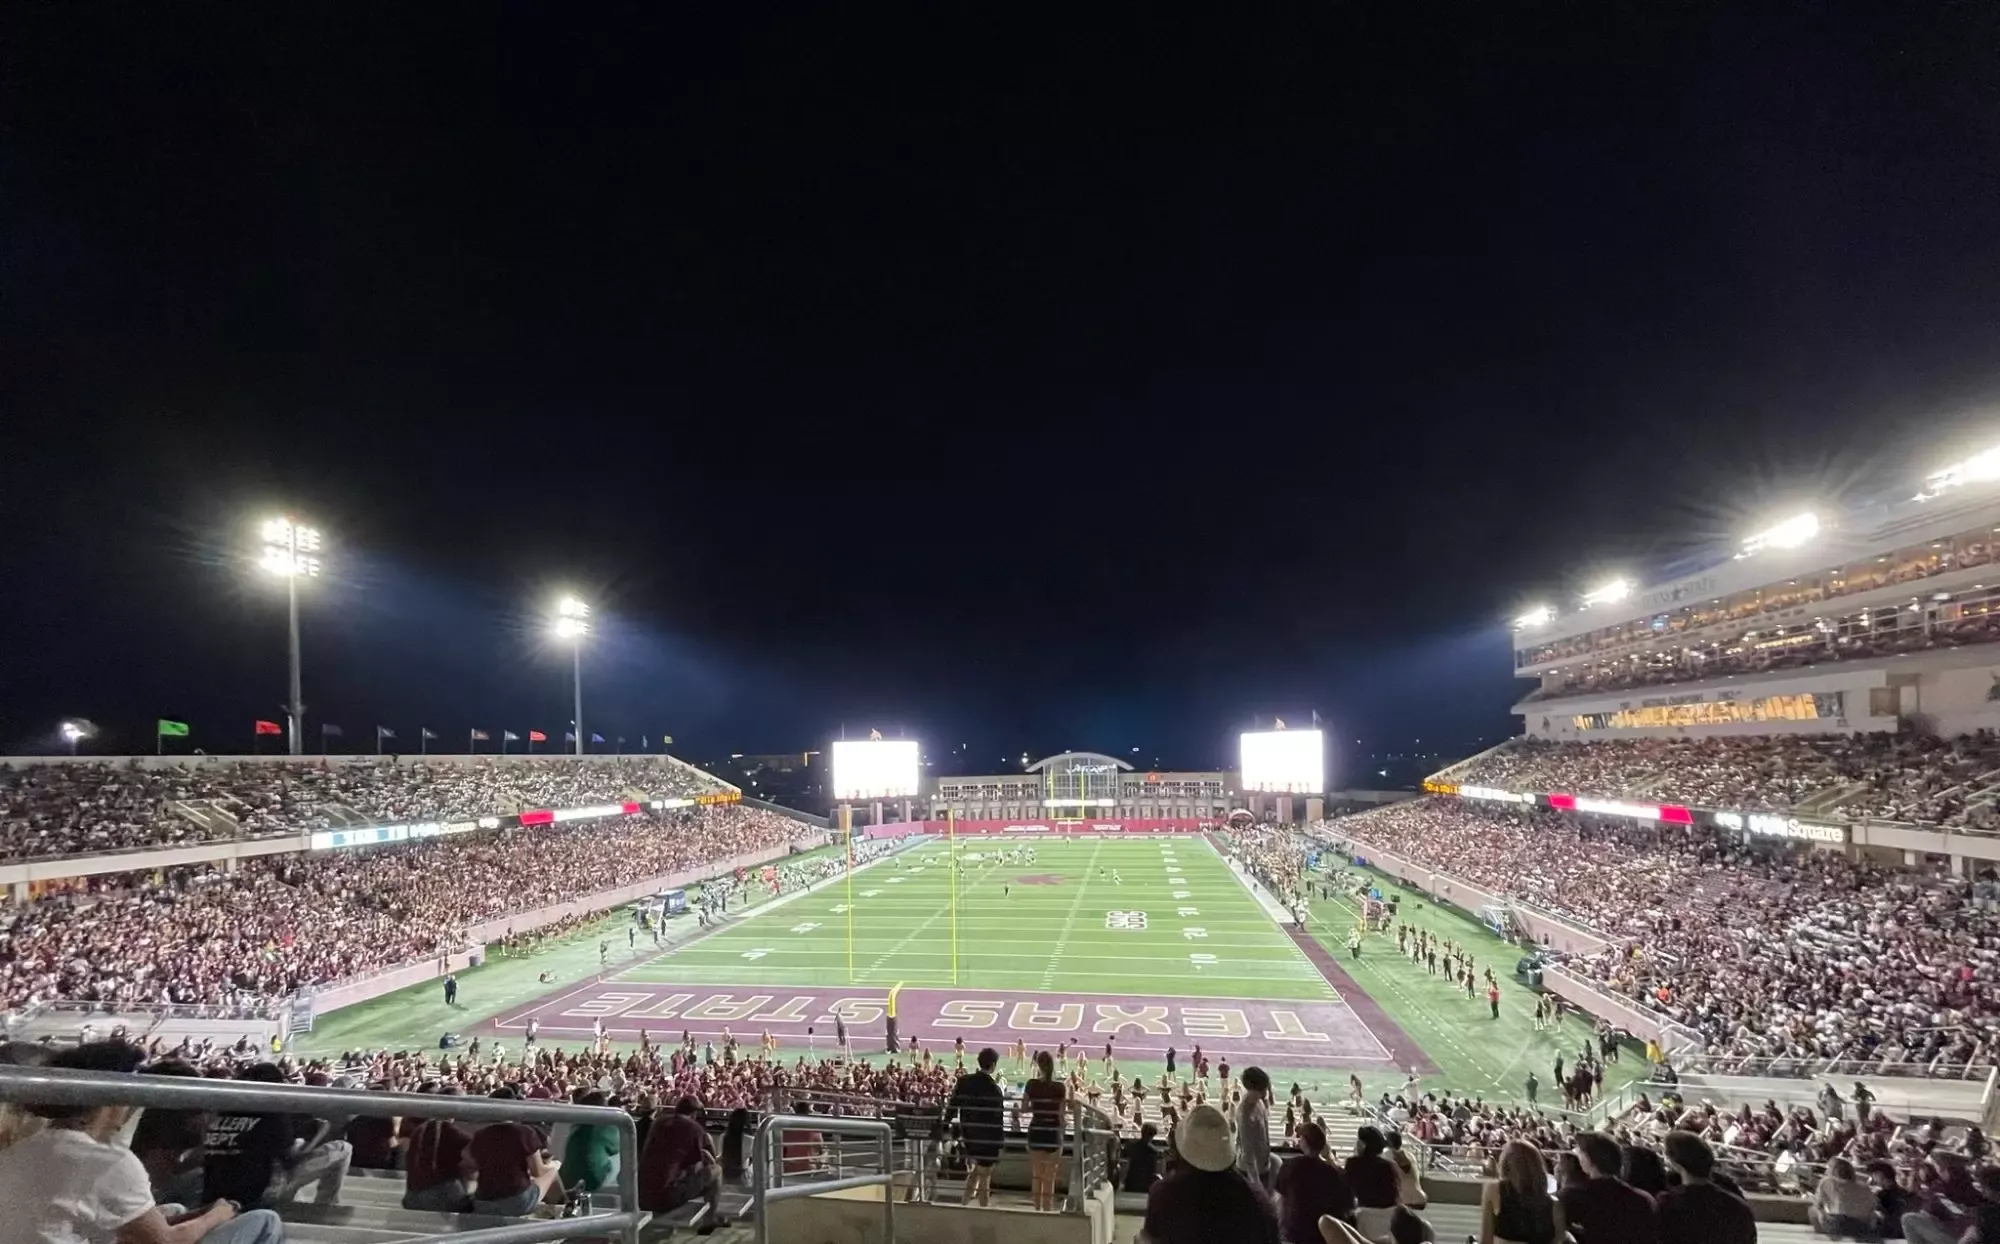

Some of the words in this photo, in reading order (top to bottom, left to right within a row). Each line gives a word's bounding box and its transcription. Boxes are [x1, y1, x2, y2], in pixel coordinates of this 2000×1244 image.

[1788, 818, 1843, 842] Square
[560, 992, 891, 1024] STATE
[931, 1000, 1331, 1042] TEXAS
